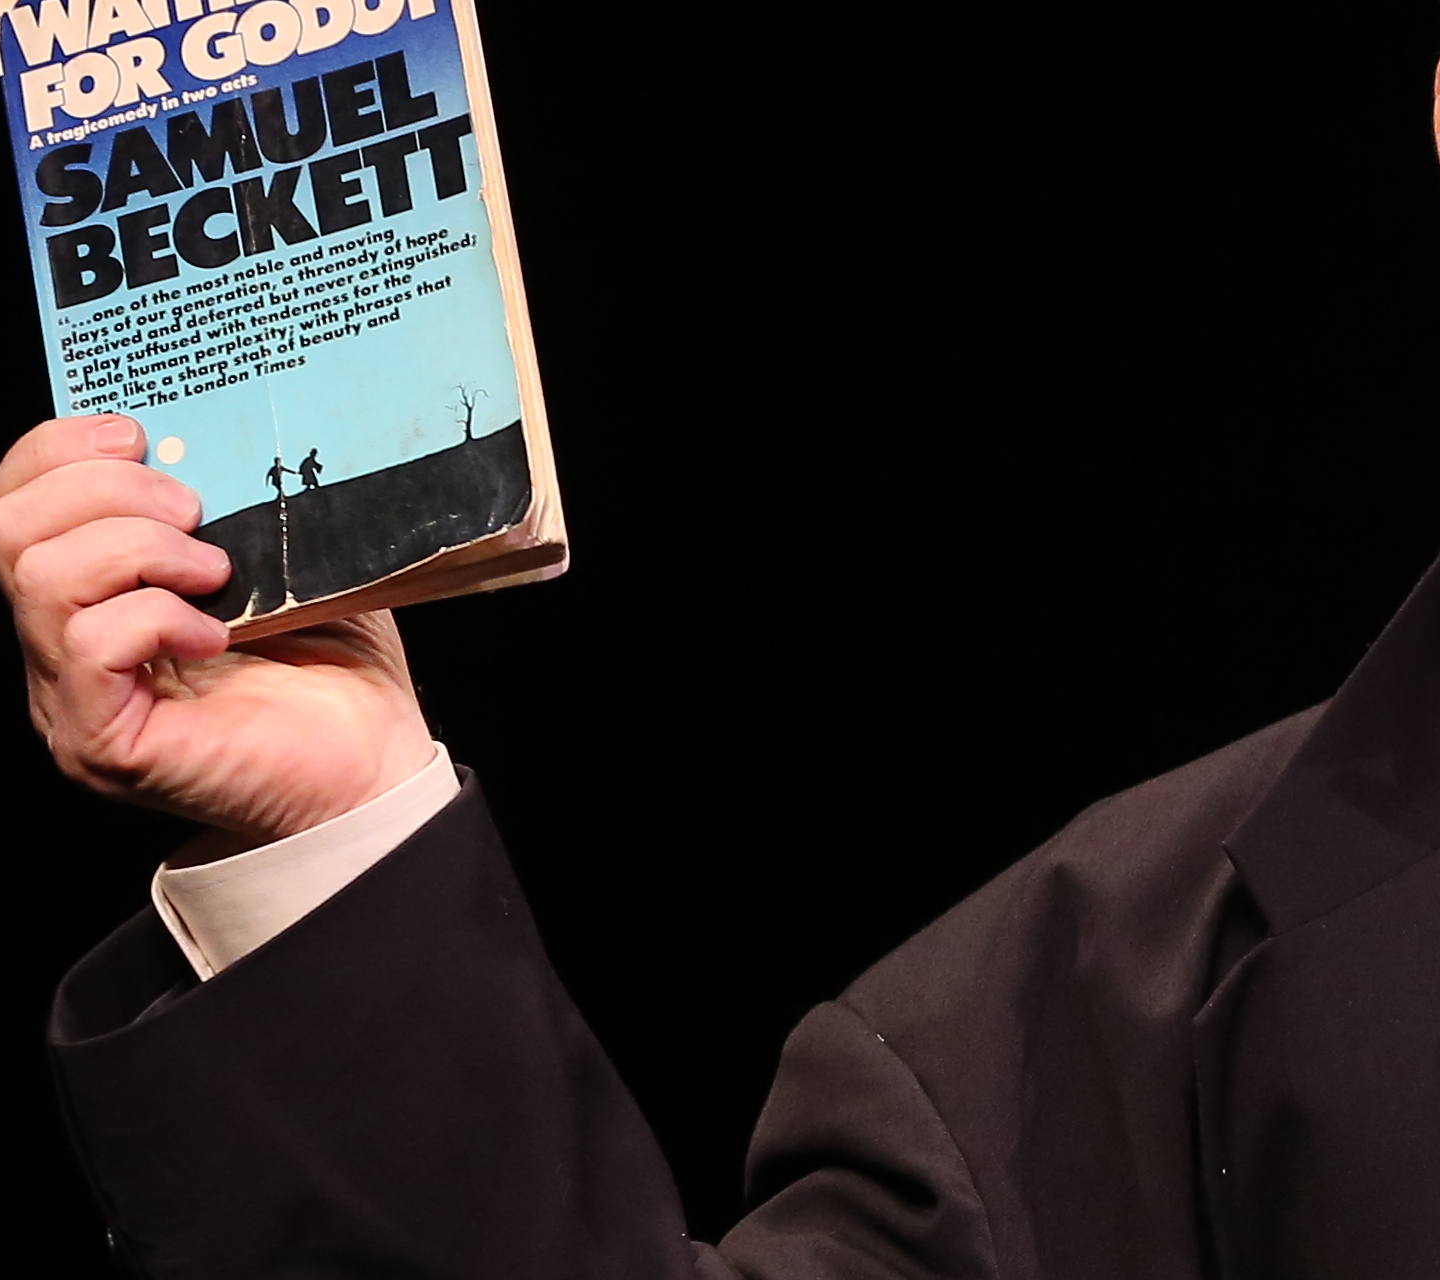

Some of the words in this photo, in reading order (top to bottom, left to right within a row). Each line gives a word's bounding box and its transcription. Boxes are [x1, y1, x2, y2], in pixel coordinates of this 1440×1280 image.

[19, 35, 172, 134] FOR
[29, 134, 44, 150] A
[46, 102, 158, 145] tragicomedy
[162, 96, 179, 111] in
[181, 86, 218, 106] two
[221, 73, 258, 94] acts
[36, 50, 439, 228] SAMUEL
[45, 112, 472, 311] BECKETT
[129, 294, 148, 311] of
[151, 289, 181, 305] the
[186, 273, 230, 296] most
[233, 259, 285, 283] noble
[289, 245, 324, 267] and
[328, 229, 395, 256] moving
[61, 326, 109, 351] plays
[113, 315, 132, 333] of
[136, 310, 166, 326] our
[171, 281, 277, 319] generation,
[282, 275, 294, 286] a
[297, 248, 379, 281] threnody
[383, 238, 402, 256] of
[405, 228, 448, 250] hope
[62, 329, 143, 363] deceived
[147, 316, 182, 340] and
[186, 294, 265, 329] deferred
[269, 287, 299, 306] but
[303, 274, 354, 297] never
[359, 232, 477, 281] extinguished;
[66, 368, 78, 379] a
[82, 356, 121, 387] play
[126, 329, 202, 363] suffused
[206, 318, 246, 340] with
[249, 292, 349, 328] tenderness
[353, 283, 379, 299] for
[383, 268, 412, 290] the
[69, 367, 124, 394] whole
[127, 354, 190, 379] human
[194, 325, 294, 364] perplexity;
[299, 309, 339, 331] with
[343, 290, 413, 323] phrases
[416, 275, 451, 296] that
[71, 391, 119, 411] come
[122, 380, 157, 397] like
[161, 375, 173, 387] a
[177, 360, 229, 382] sharp
[233, 345, 272, 367] stab
[276, 337, 295, 354] of
[299, 322, 361, 348] beauty
[367, 306, 401, 329] and
[184, 370, 249, 397] London
[253, 355, 306, 377] Times
